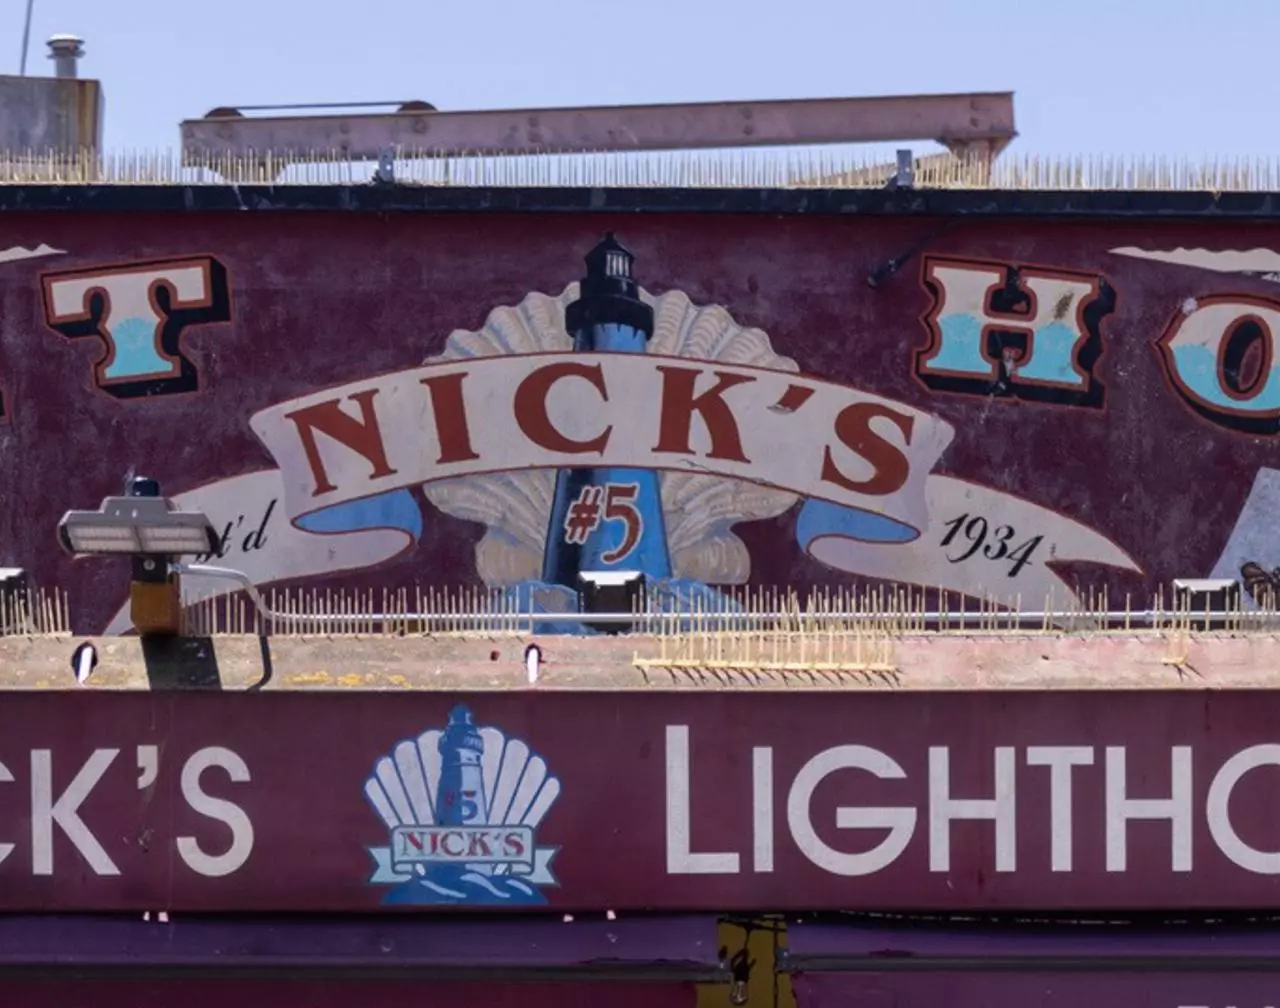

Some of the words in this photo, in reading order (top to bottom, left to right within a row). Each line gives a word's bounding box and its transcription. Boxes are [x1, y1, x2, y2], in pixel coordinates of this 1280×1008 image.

[284, 362, 917, 496] NICK'S
[563, 481, 642, 566] #5
[939, 510, 1044, 577] 1934
[398, 830, 526, 858] NICK'S
